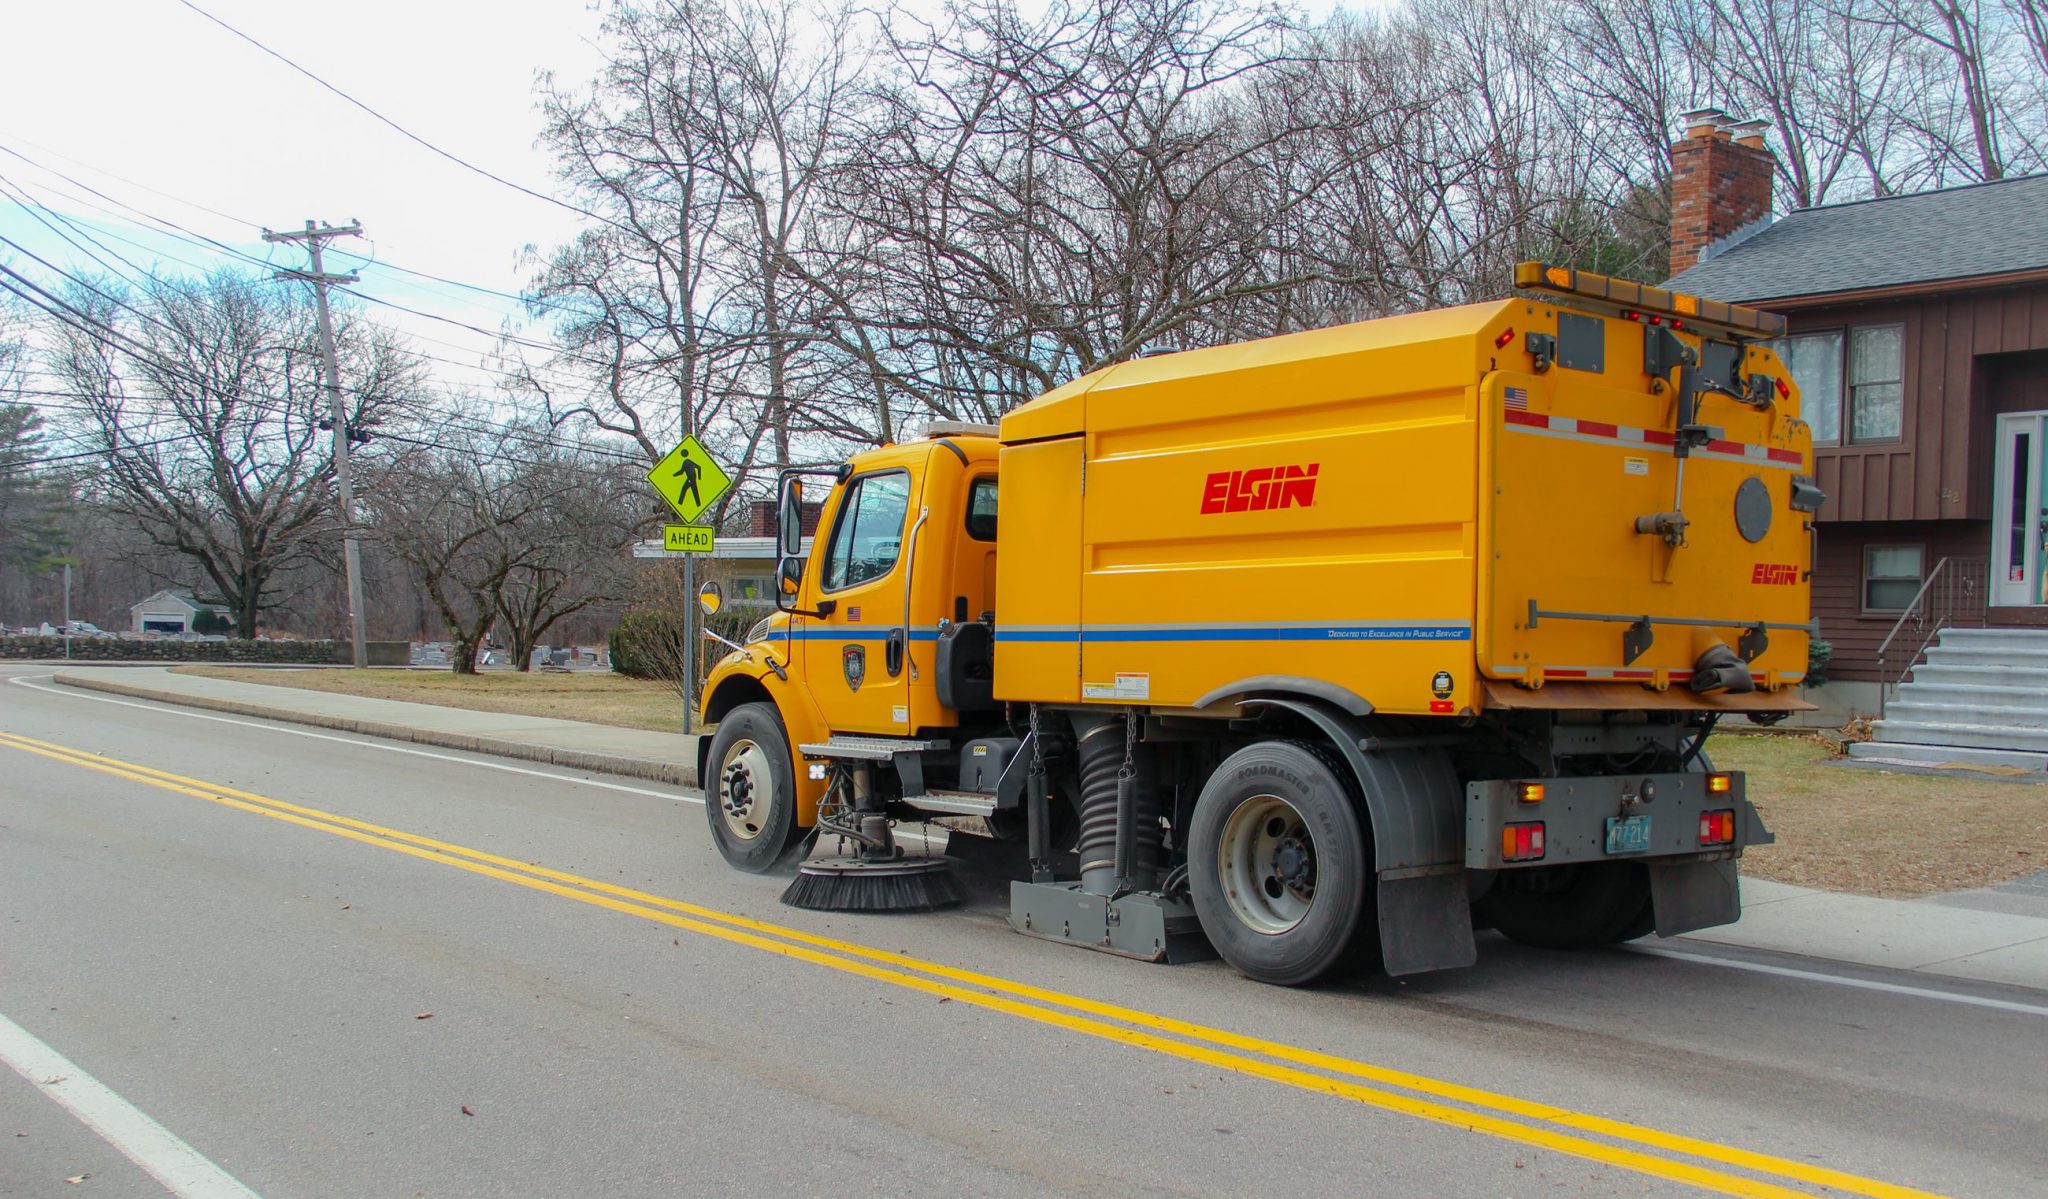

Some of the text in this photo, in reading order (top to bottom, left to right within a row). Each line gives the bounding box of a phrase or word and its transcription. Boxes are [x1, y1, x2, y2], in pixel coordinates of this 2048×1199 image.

[1200, 463, 1320, 515] ELGIN
[670, 532, 708, 546] AHEAD
[1752, 563, 1798, 586] ELGIN
[1238, 765, 1310, 796] ROADMASTER
